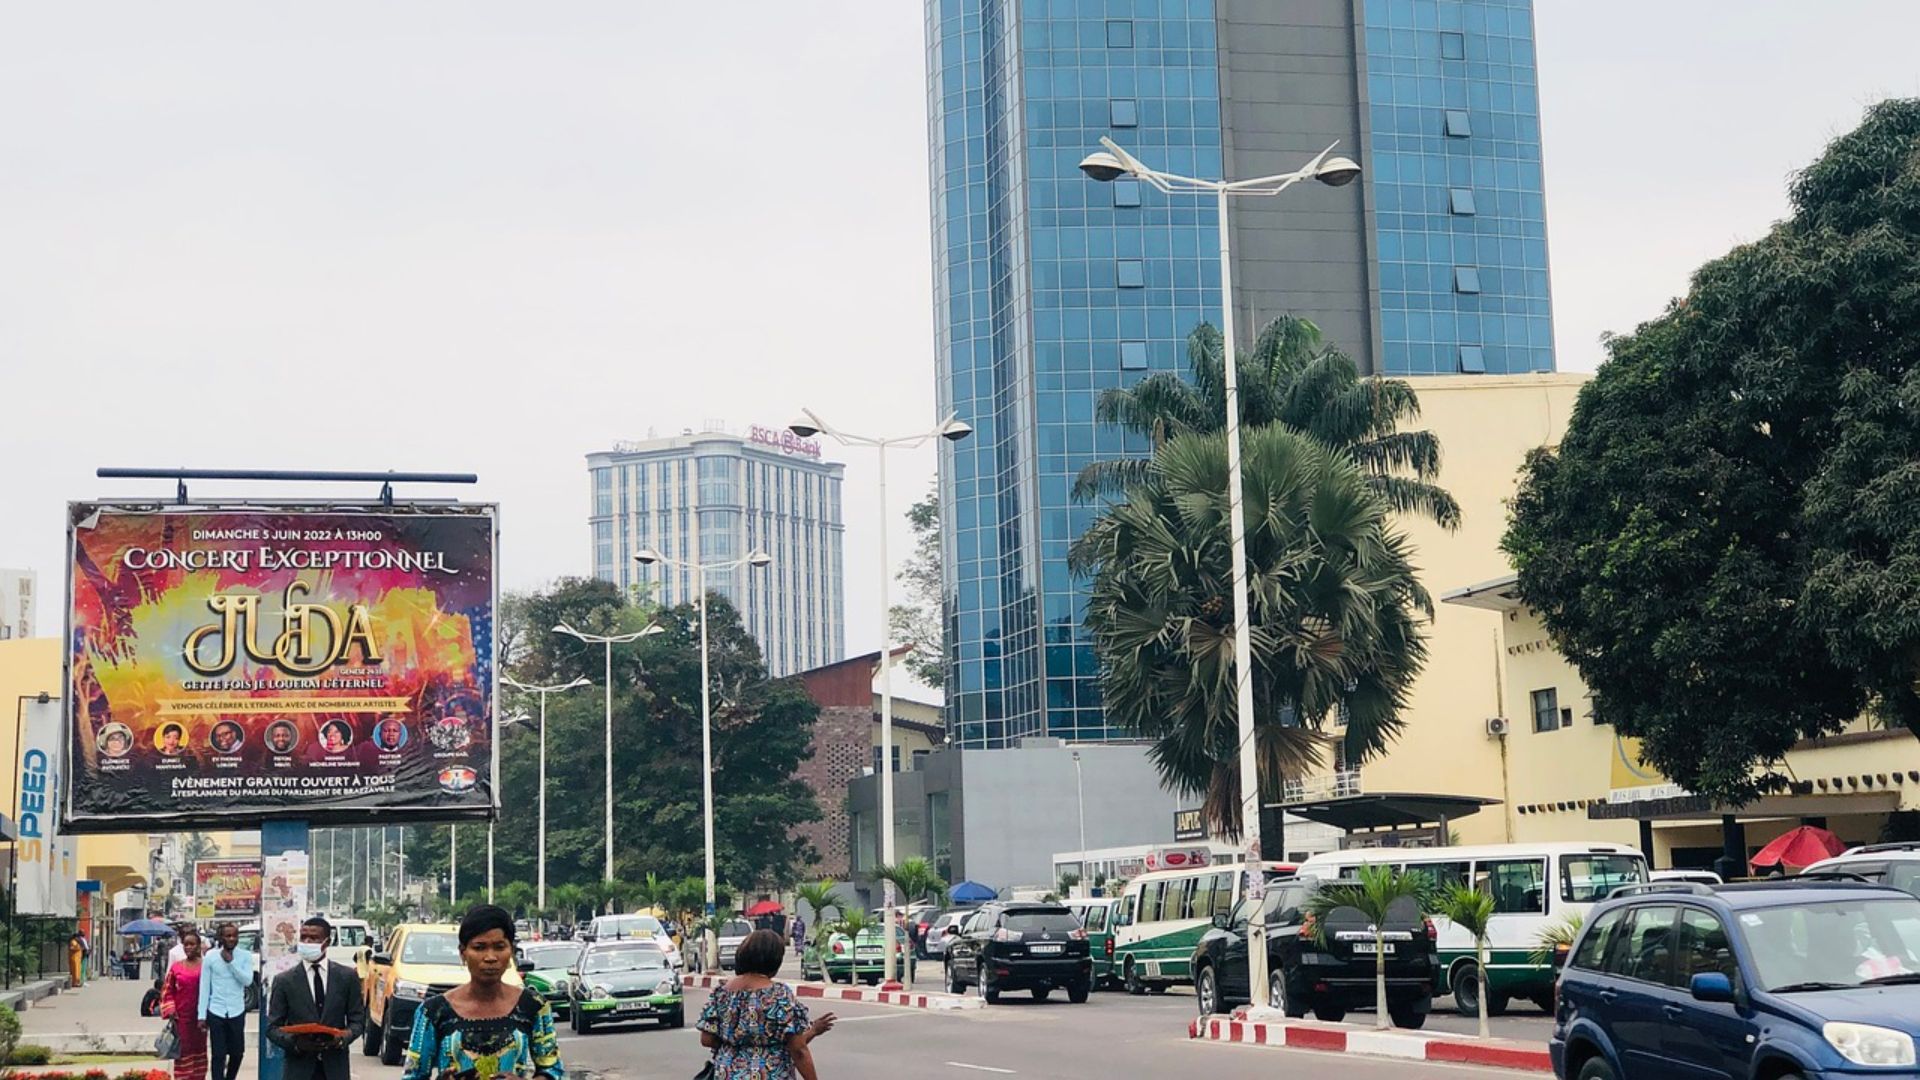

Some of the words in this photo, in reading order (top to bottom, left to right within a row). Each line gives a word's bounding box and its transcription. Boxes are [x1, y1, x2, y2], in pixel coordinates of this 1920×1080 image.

[751, 426, 780, 447] BSCA
[192, 529, 259, 540] DIMANCHE
[262, 529, 270, 540] 5
[271, 530, 301, 541] JUIN
[303, 530, 332, 541] 2022
[333, 528, 344, 540] À
[346, 530, 382, 541] 13H00
[123, 547, 253, 572] CONCERT
[259, 546, 460, 574] EXCEPTIONNEL
[184, 580, 384, 672] JUDA
[224, 679, 252, 690] FOIS
[254, 680, 266, 691] JE
[269, 678, 321, 690] LOUERAI
[204, 701, 243, 710] CÉLÉBRER
[362, 700, 397, 708] ARTISTES
[171, 775, 244, 789] ÉVÈNEMENT
[246, 776, 299, 788] GRATUIT
[301, 776, 350, 788] OUVERT
[352, 774, 361, 787] À
[363, 775, 396, 786] TOUS
[229, 788, 241, 796] DU
[242, 788, 270, 796] PALAIS
[271, 788, 283, 796] DU
[284, 788, 330, 796] PARLEMENT
[332, 788, 341, 796] DE
[19, 749, 47, 864] SPEED
